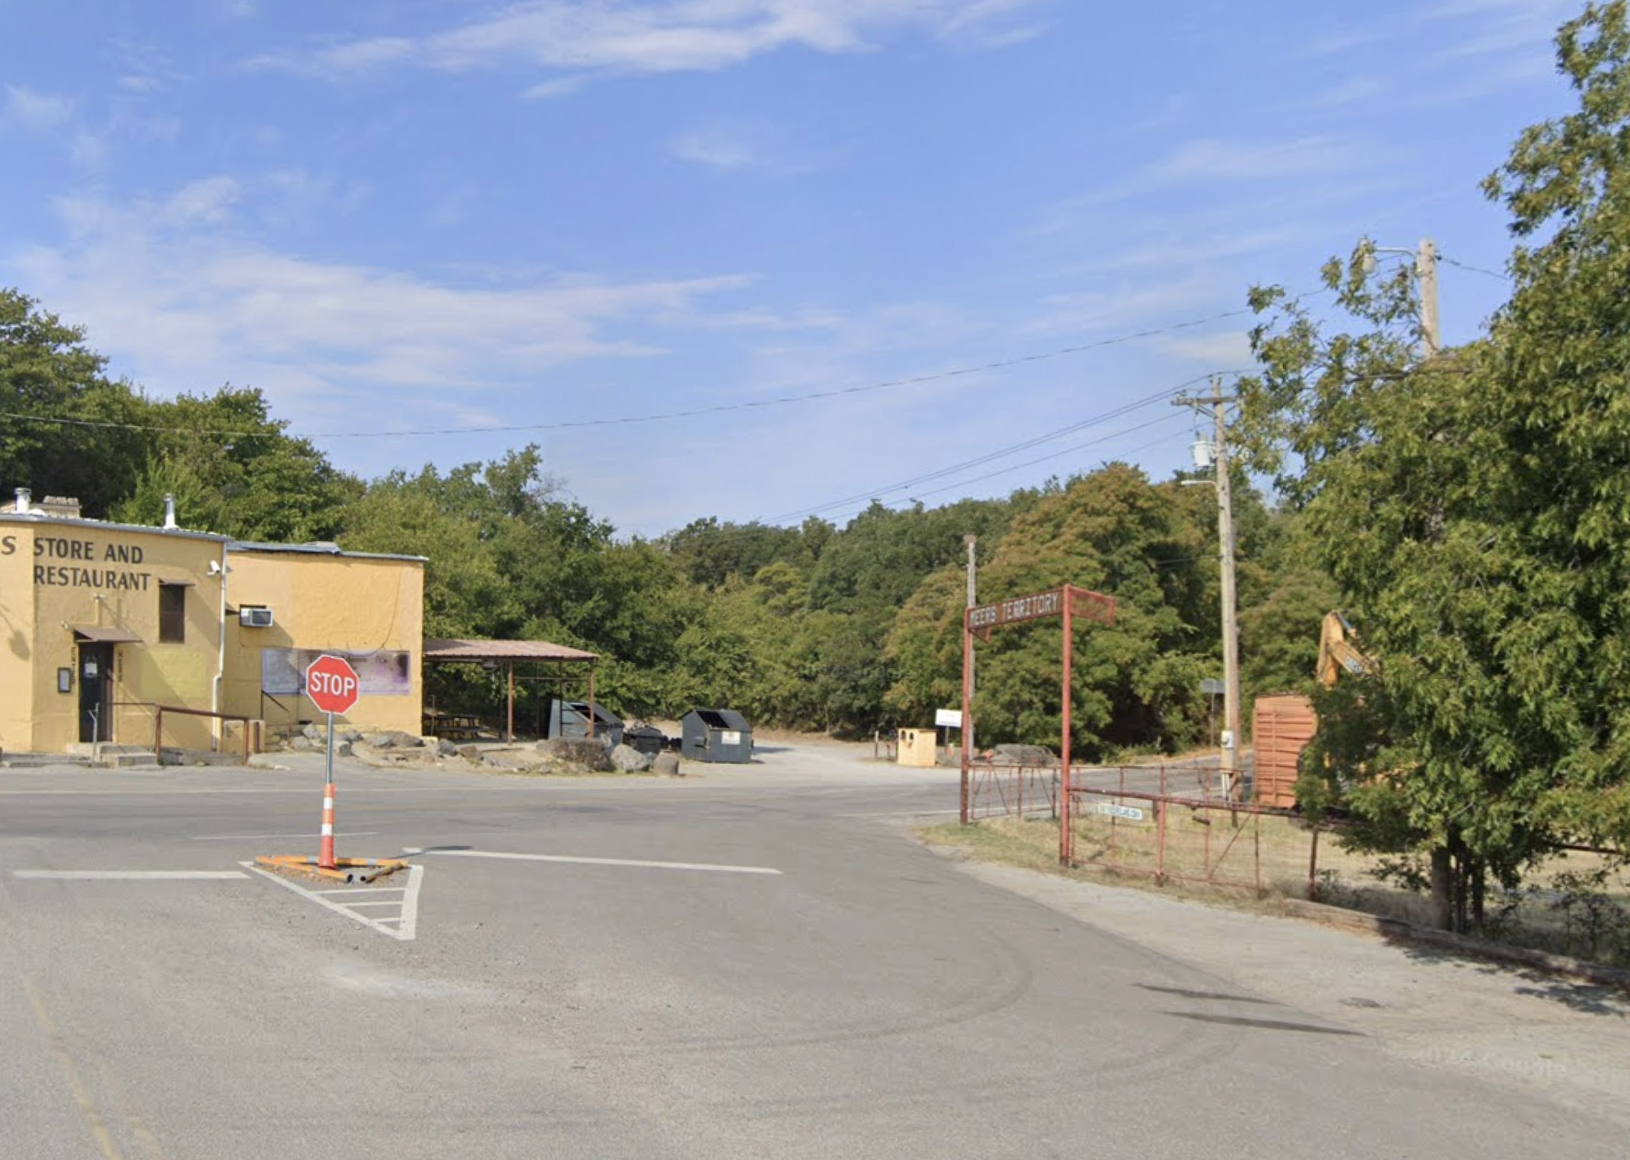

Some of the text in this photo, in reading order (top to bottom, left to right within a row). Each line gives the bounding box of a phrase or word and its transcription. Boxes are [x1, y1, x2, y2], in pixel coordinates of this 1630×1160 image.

[33, 537, 94, 560] STORE
[104, 544, 144, 564] AND
[33, 565, 151, 591] RESTAURANT
[310, 671, 356, 697] STOP
